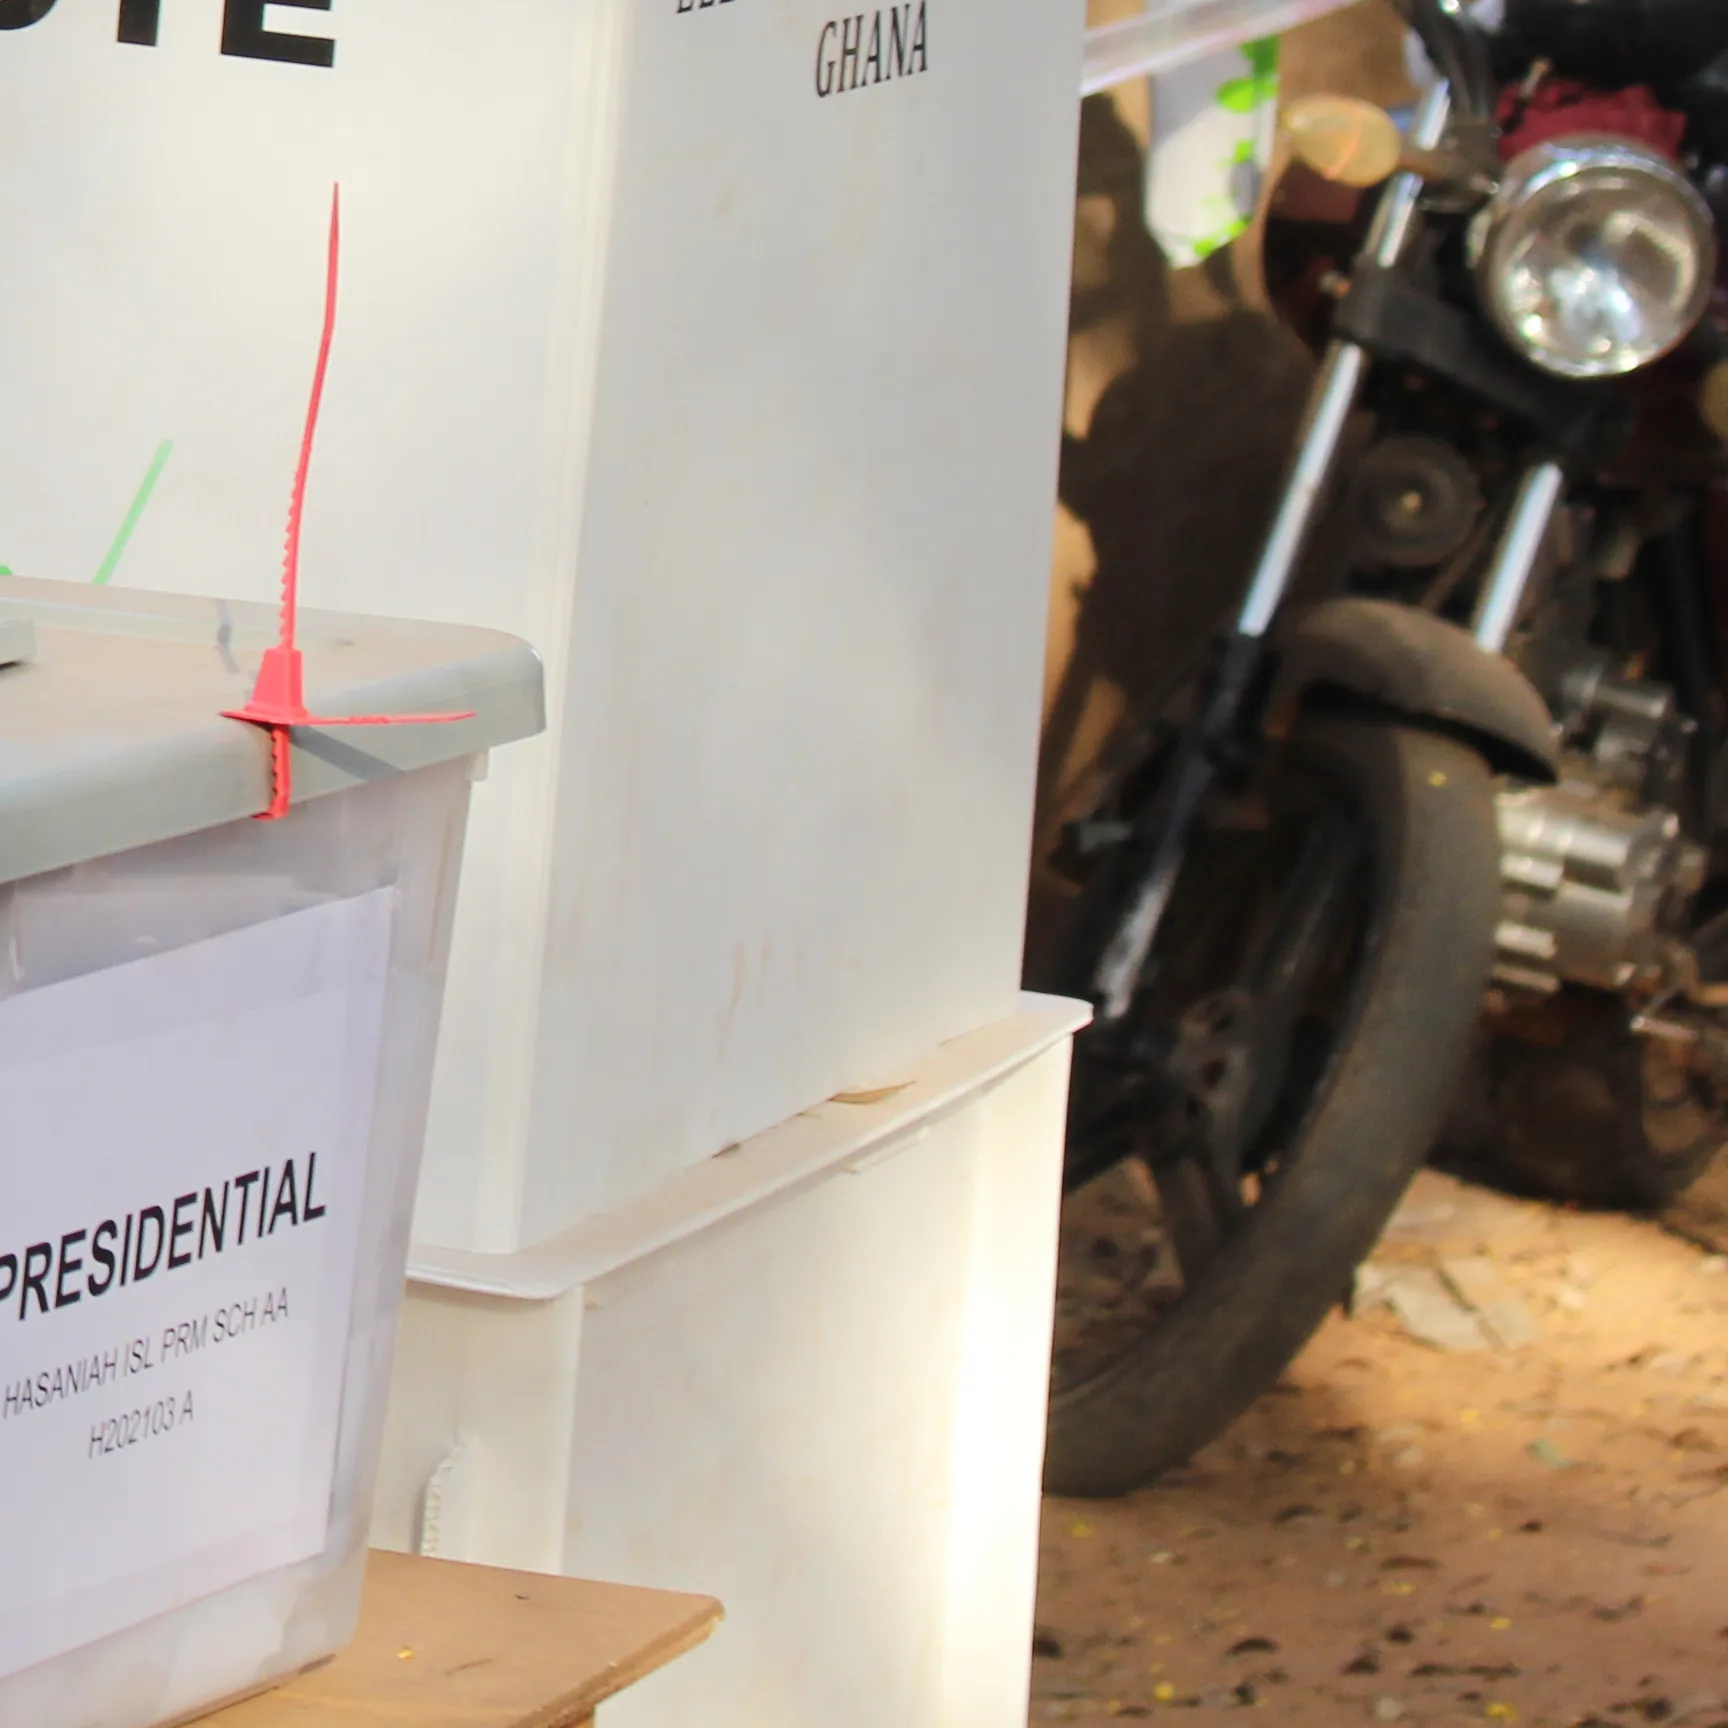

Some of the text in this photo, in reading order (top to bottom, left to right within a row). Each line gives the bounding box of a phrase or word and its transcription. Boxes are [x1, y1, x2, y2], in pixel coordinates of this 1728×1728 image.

[2, 1343, 118, 1420] HASANIAH
[122, 1334, 155, 1377] ISL
[213, 1295, 257, 1344] SCH
[259, 1286, 289, 1322] AA
[88, 1389, 195, 1460] H202103 A
